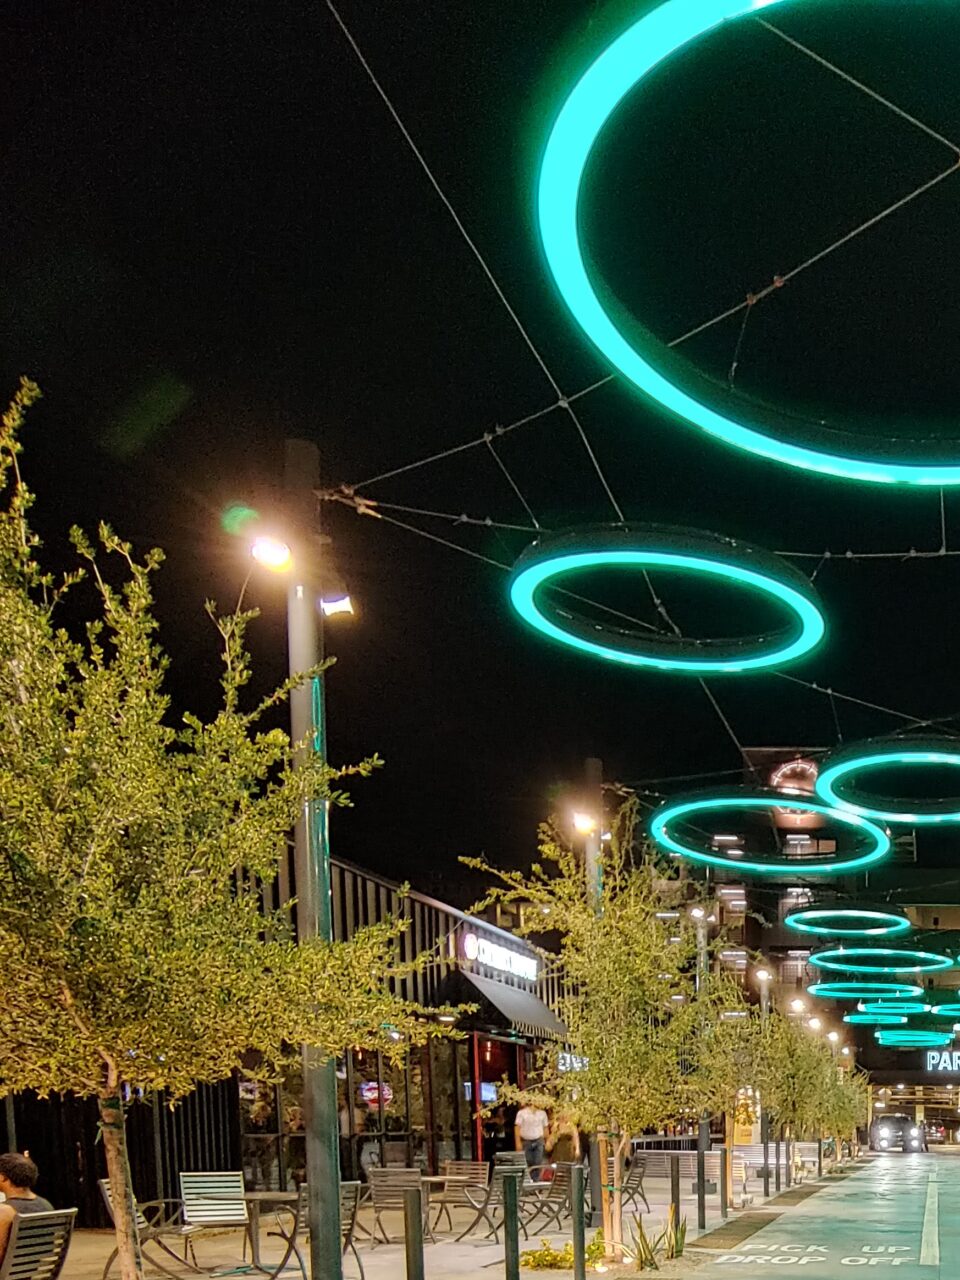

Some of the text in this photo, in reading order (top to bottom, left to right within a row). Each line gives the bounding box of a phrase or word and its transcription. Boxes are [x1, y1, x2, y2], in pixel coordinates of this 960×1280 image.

[742, 1244, 912, 1253] PICK UP
[715, 1254, 916, 1265] DROP OFF
